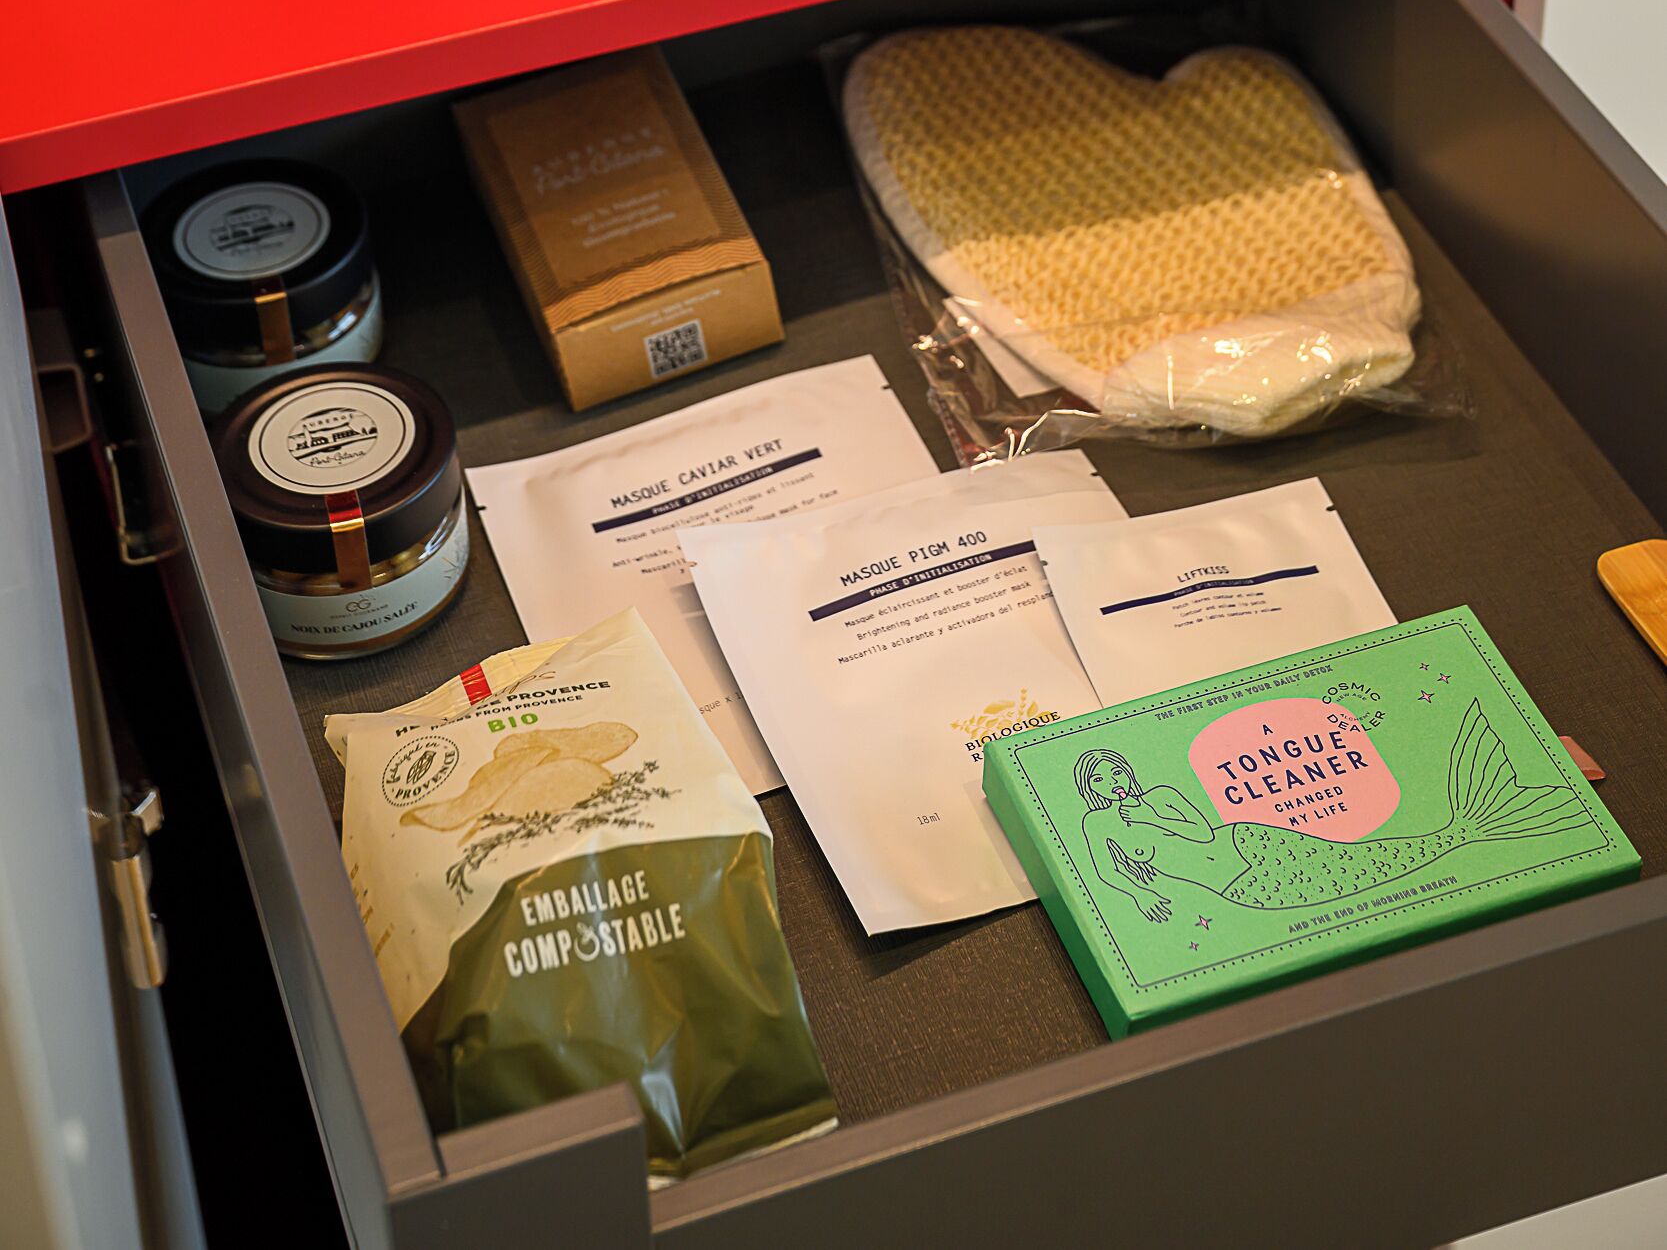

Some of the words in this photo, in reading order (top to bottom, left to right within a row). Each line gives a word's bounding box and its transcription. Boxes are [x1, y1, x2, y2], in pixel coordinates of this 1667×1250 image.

[610, 479, 671, 509] MASQUE
[678, 455, 738, 485] CAVIAR
[743, 438, 784, 461] VERT
[641, 556, 687, 575] Mascarill
[839, 556, 902, 588] MASQUE
[908, 541, 951, 564] PIGM
[956, 530, 987, 549] 400
[868, 581, 900, 598] PHASE
[901, 553, 993, 587] D'INITIALISATION
[1176, 565, 1231, 583] LIFTKISS
[844, 612, 875, 628] Masque
[878, 592, 941, 617] éclaircissant
[943, 586, 954, 597] et
[957, 575, 991, 592] booster
[994, 565, 1029, 581] d'éclat
[856, 617, 912, 641] Brightening
[914, 611, 930, 623] and
[932, 599, 972, 618] radiance
[973, 588, 1008, 605] booster
[1010, 580, 1033, 593] mask
[290, 622, 321, 634] NOIX
[323, 625, 341, 634] DE
[342, 616, 382, 633] CAJOU
[838, 642, 888, 665] Mascarilla
[891, 627, 935, 649] aclarante
[937, 626, 945, 636] y
[947, 610, 996, 632] activadora
[998, 603, 1014, 616] del
[506, 681, 612, 703] PROVENCE
[1154, 709, 1175, 721] THE
[1177, 700, 1204, 716] FIRST
[1206, 693, 1230, 707] STEP
[1231, 689, 1245, 700] IN
[1246, 682, 1272, 697] YOUR
[1275, 673, 1302, 689] DAILY
[1303, 664, 1334, 679] DETOX
[1321, 682, 1381, 705] COSMIC
[1336, 692, 1350, 703] NEW
[1352, 692, 1367, 702] AGE
[475, 705, 512, 719] FROM
[515, 695, 584, 711] PROVENCE
[699, 700, 721, 715] sque
[1327, 710, 1386, 733] DEALER
[1340, 711, 1371, 722] ALCHEMY
[487, 713, 540, 734] BIO
[965, 711, 1061, 752] BIOLOGIQUE
[1262, 724, 1274, 736] A
[1216, 730, 1347, 781] TONGUE
[394, 750, 456, 800] PROVENCE
[1224, 750, 1369, 805] CLEANER
[1274, 785, 1344, 814] CHANGED
[1288, 812, 1308, 827] MY
[1313, 801, 1349, 820] LIFE
[916, 812, 942, 826] 18ml
[520, 869, 650, 927] EMBALLAGE
[1288, 922, 1310, 934] AND
[1310, 913, 1332, 927] THE
[1333, 907, 1354, 920] END
[1356, 901, 1370, 912] OF
[1371, 888, 1418, 909] MORNING
[1418, 874, 1458, 894] BREATH
[503, 902, 687, 978] COMPOSTABLE
